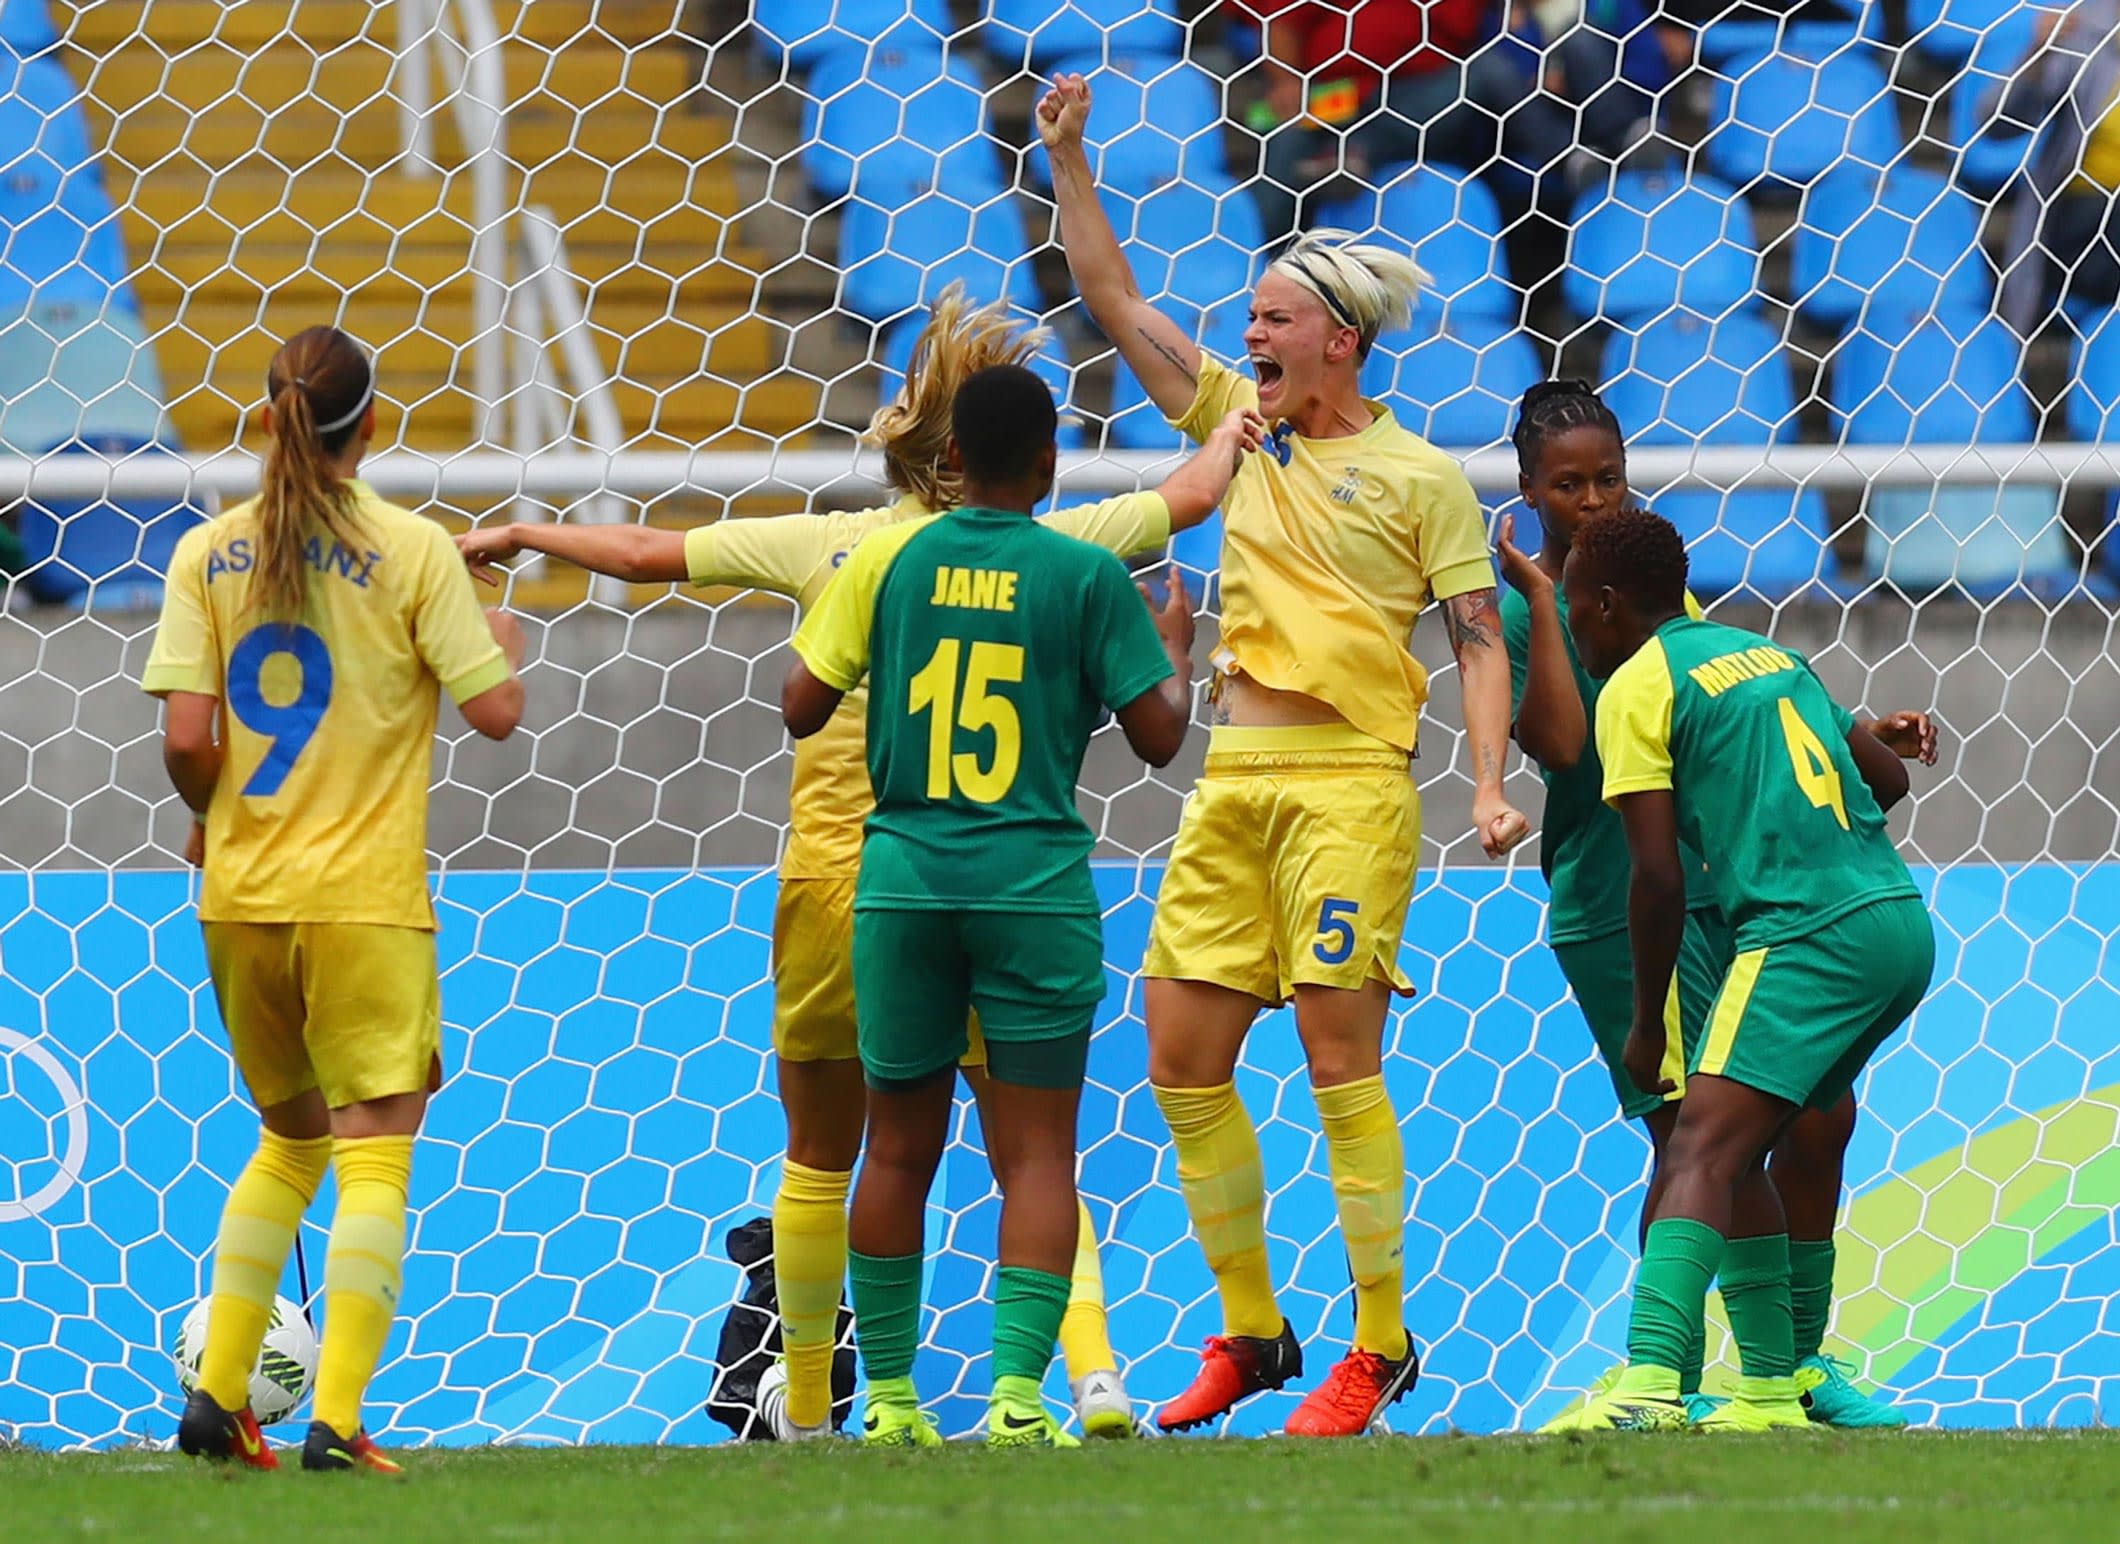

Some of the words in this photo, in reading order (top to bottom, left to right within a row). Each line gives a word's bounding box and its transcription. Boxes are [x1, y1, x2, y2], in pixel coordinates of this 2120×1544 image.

[206, 536, 382, 588] ASANI
[930, 566, 1019, 612] JANE
[227, 621, 334, 797] 9
[908, 638, 1025, 804] 15
[1777, 697, 1850, 832] 4
[1312, 897, 1360, 965] 5
